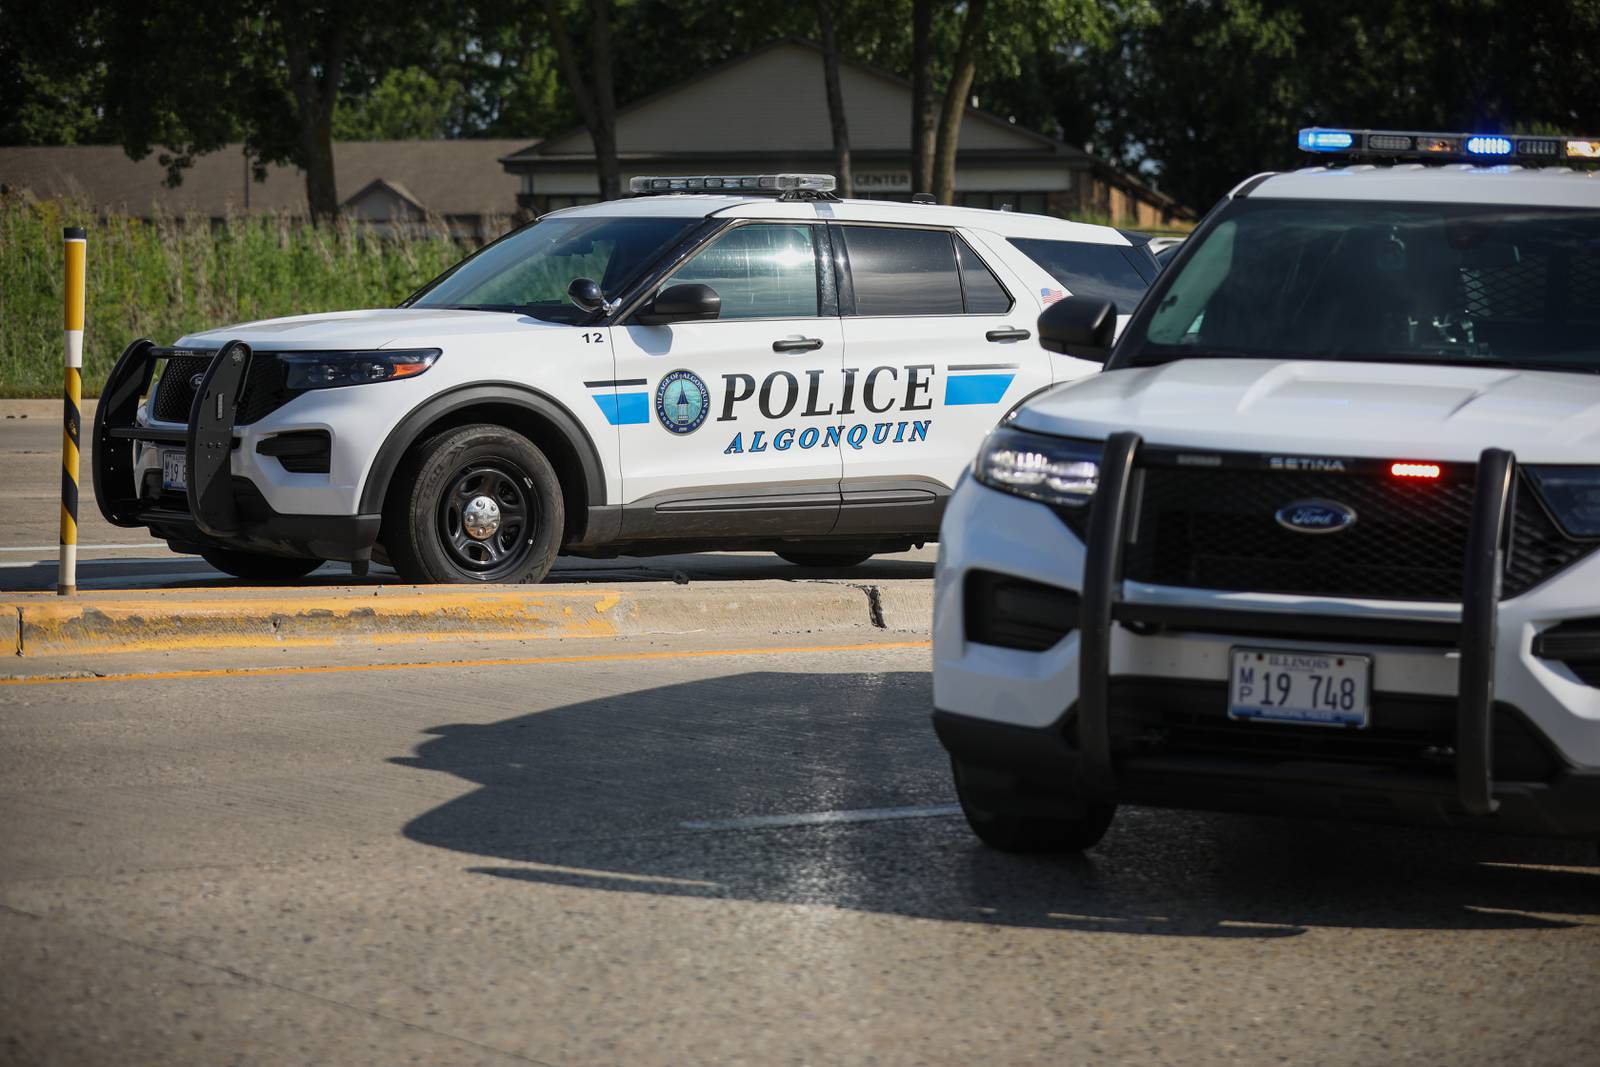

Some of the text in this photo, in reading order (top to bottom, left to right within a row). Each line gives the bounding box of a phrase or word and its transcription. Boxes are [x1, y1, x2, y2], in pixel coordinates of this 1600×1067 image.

[855, 175, 910, 186] CENTER
[581, 332, 604, 343] 12
[657, 372, 709, 409] VILLAGE OF ALGONQUIN
[717, 364, 935, 422] POLICE
[724, 420, 931, 454] ALGONQUIN
[1270, 457, 1345, 471] SETINA
[1260, 672, 1291, 706] 19
[1309, 675, 1355, 711] 748
